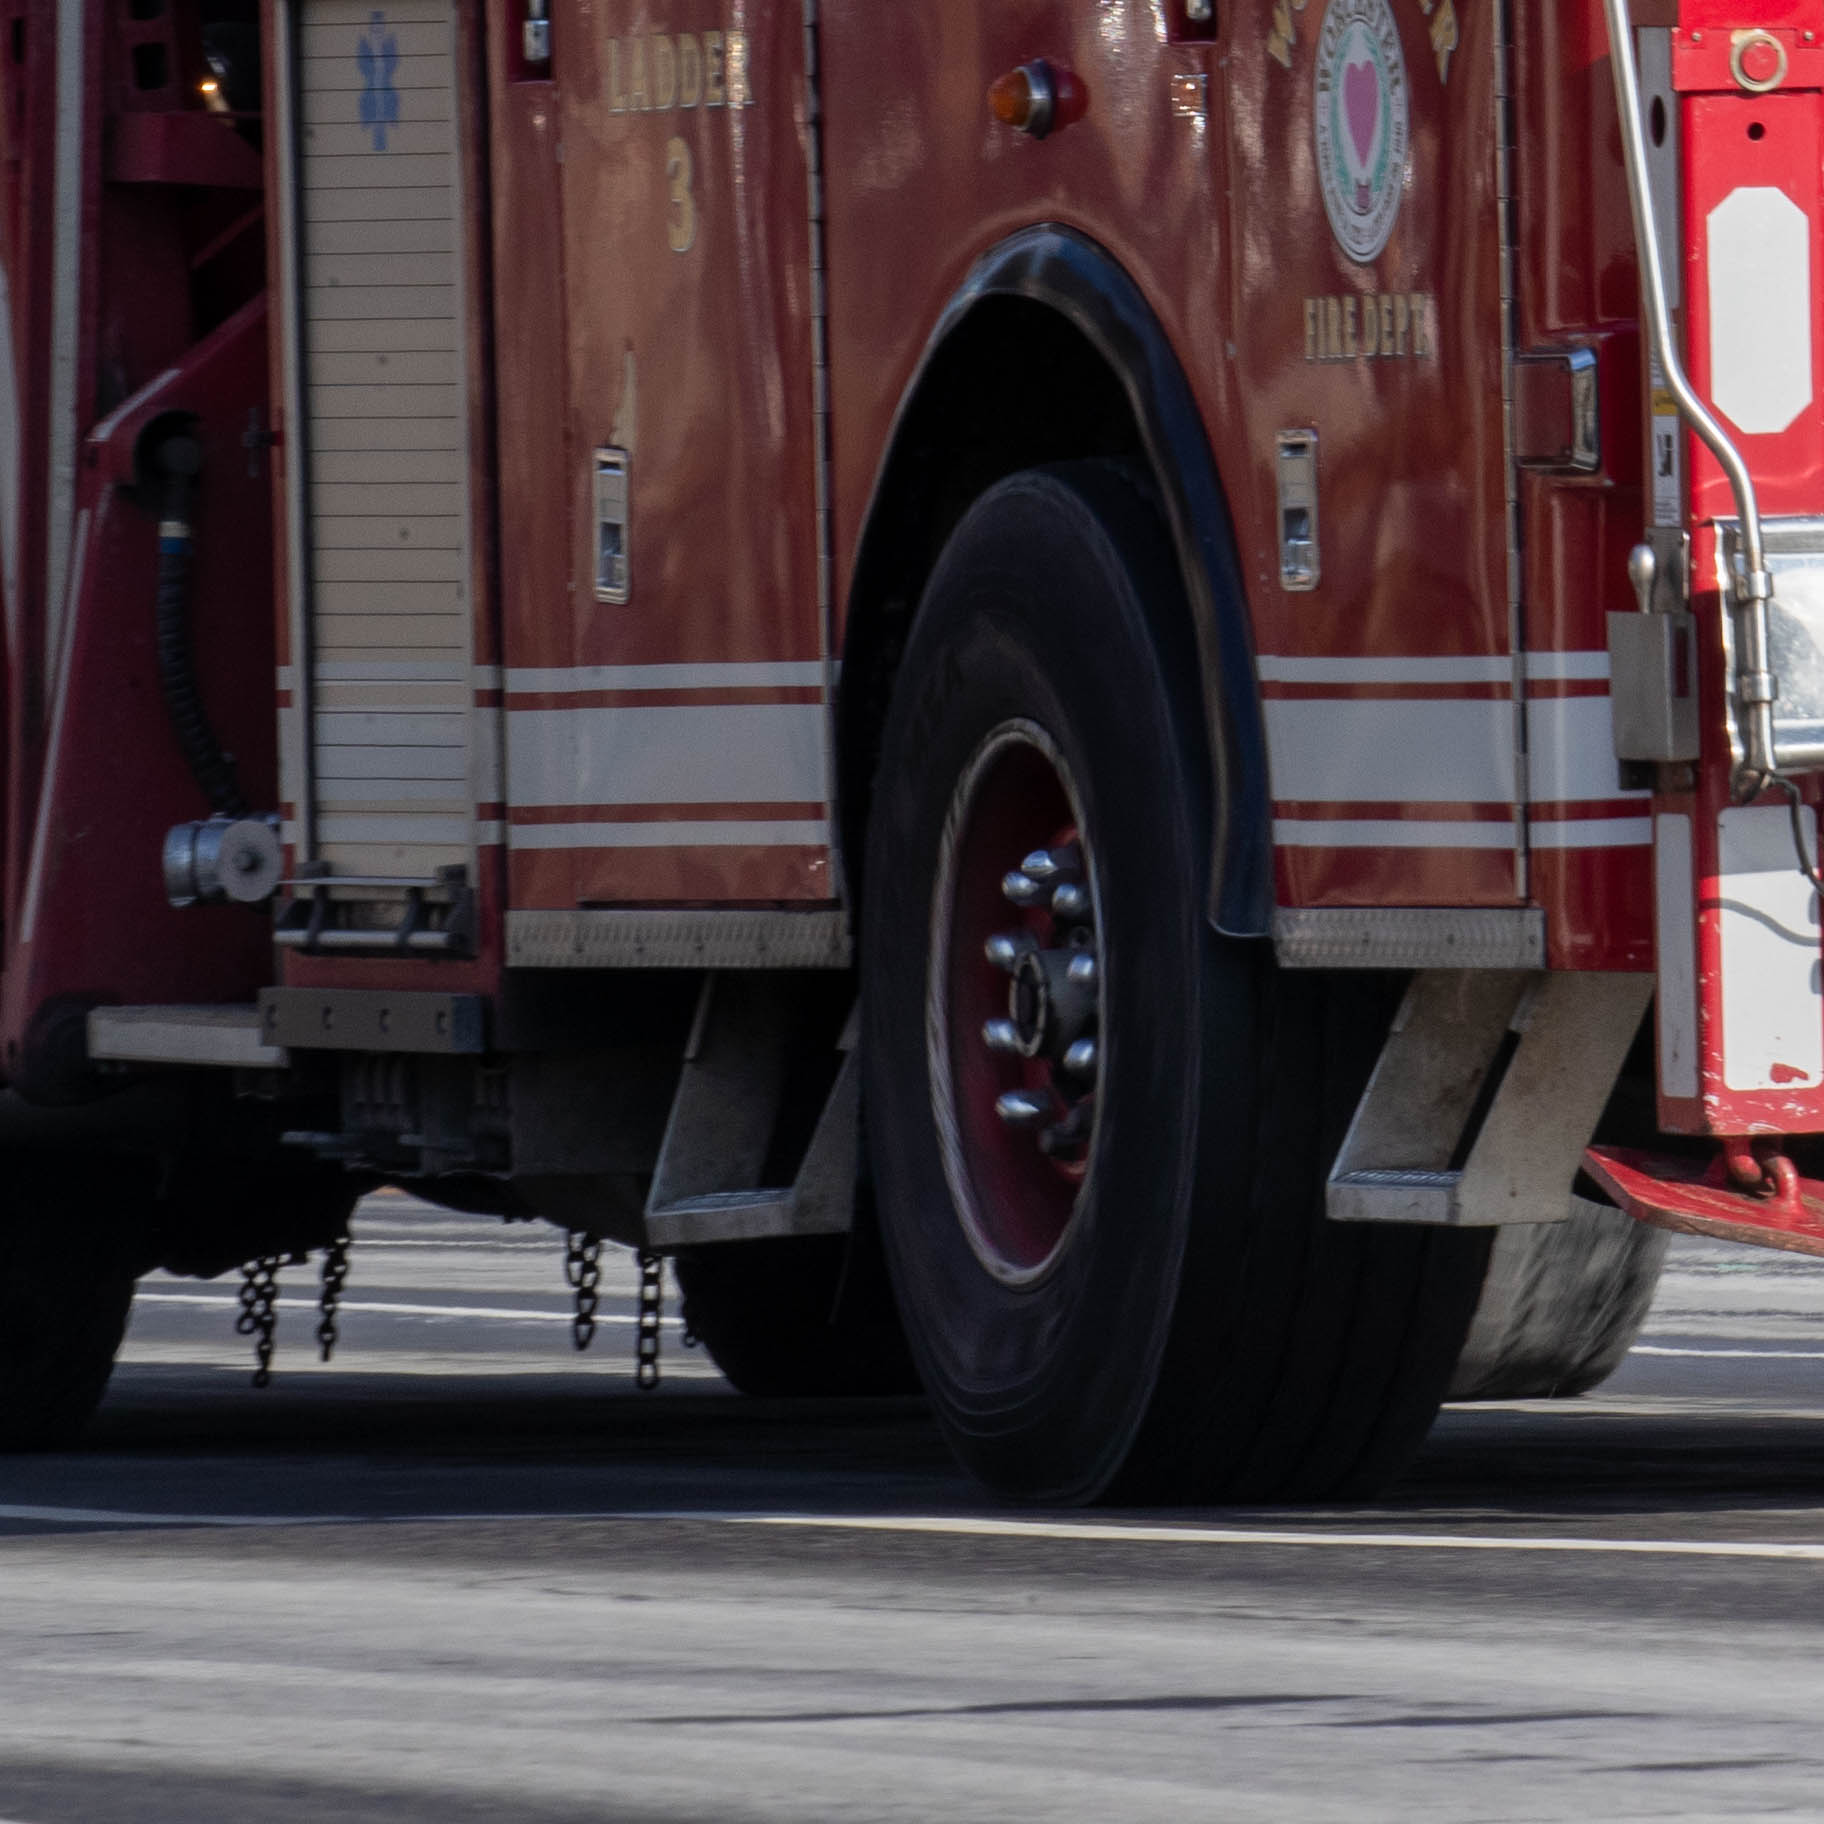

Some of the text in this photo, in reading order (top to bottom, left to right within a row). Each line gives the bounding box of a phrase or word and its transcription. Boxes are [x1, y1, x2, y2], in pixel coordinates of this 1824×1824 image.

[608, 30, 754, 112] LADDER
[666, 137, 696, 252] 3
[1304, 295, 1359, 362] FIRE
